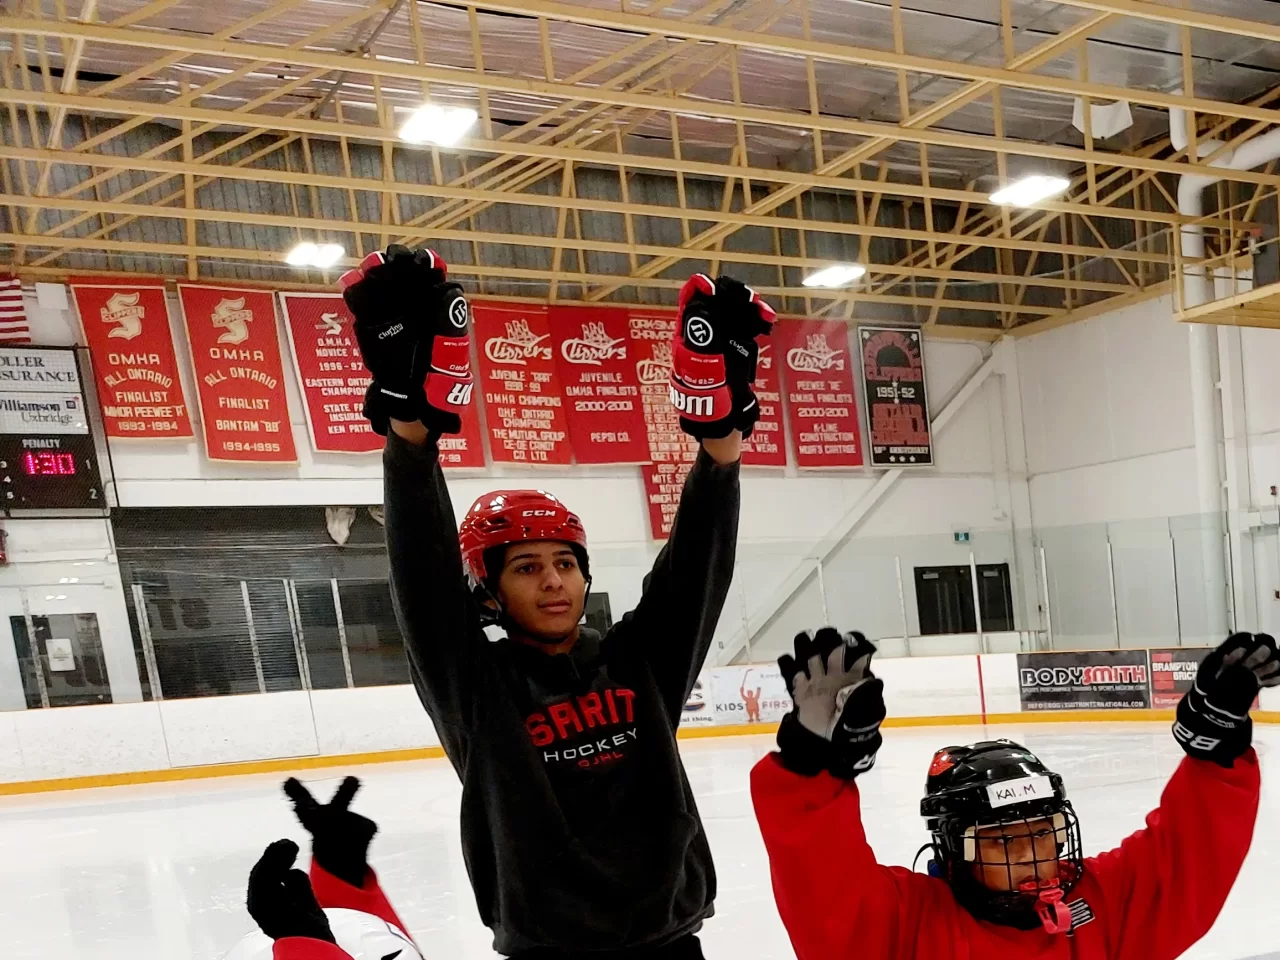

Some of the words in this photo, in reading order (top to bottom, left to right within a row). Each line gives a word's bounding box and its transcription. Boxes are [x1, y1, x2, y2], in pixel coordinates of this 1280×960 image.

[108, 353, 161, 365] OMHA
[210, 347, 265, 362] OMHA
[127, 368, 173, 389] ONTARIO
[229, 366, 277, 390] ONTARIO
[305, 378, 344, 388] EASTERN
[579, 372, 623, 383] JUVENILE
[115, 391, 168, 403] FINALIST
[219, 397, 269, 410] FINALIST
[323, 403, 350, 413] STATE
[216, 419, 260, 432] BANTAM
[328, 425, 346, 435] KEN
[590, 432, 616, 442] PEPSI
[22, 439, 61, 450] PENALTY
[521, 509, 556, 517] CCM
[1152, 661, 1198, 672] BRAMPTON
[1020, 665, 1147, 687] BODYSMITH
[715, 702, 744, 712] KIDS
[543, 728, 637, 763] HOCKEY
